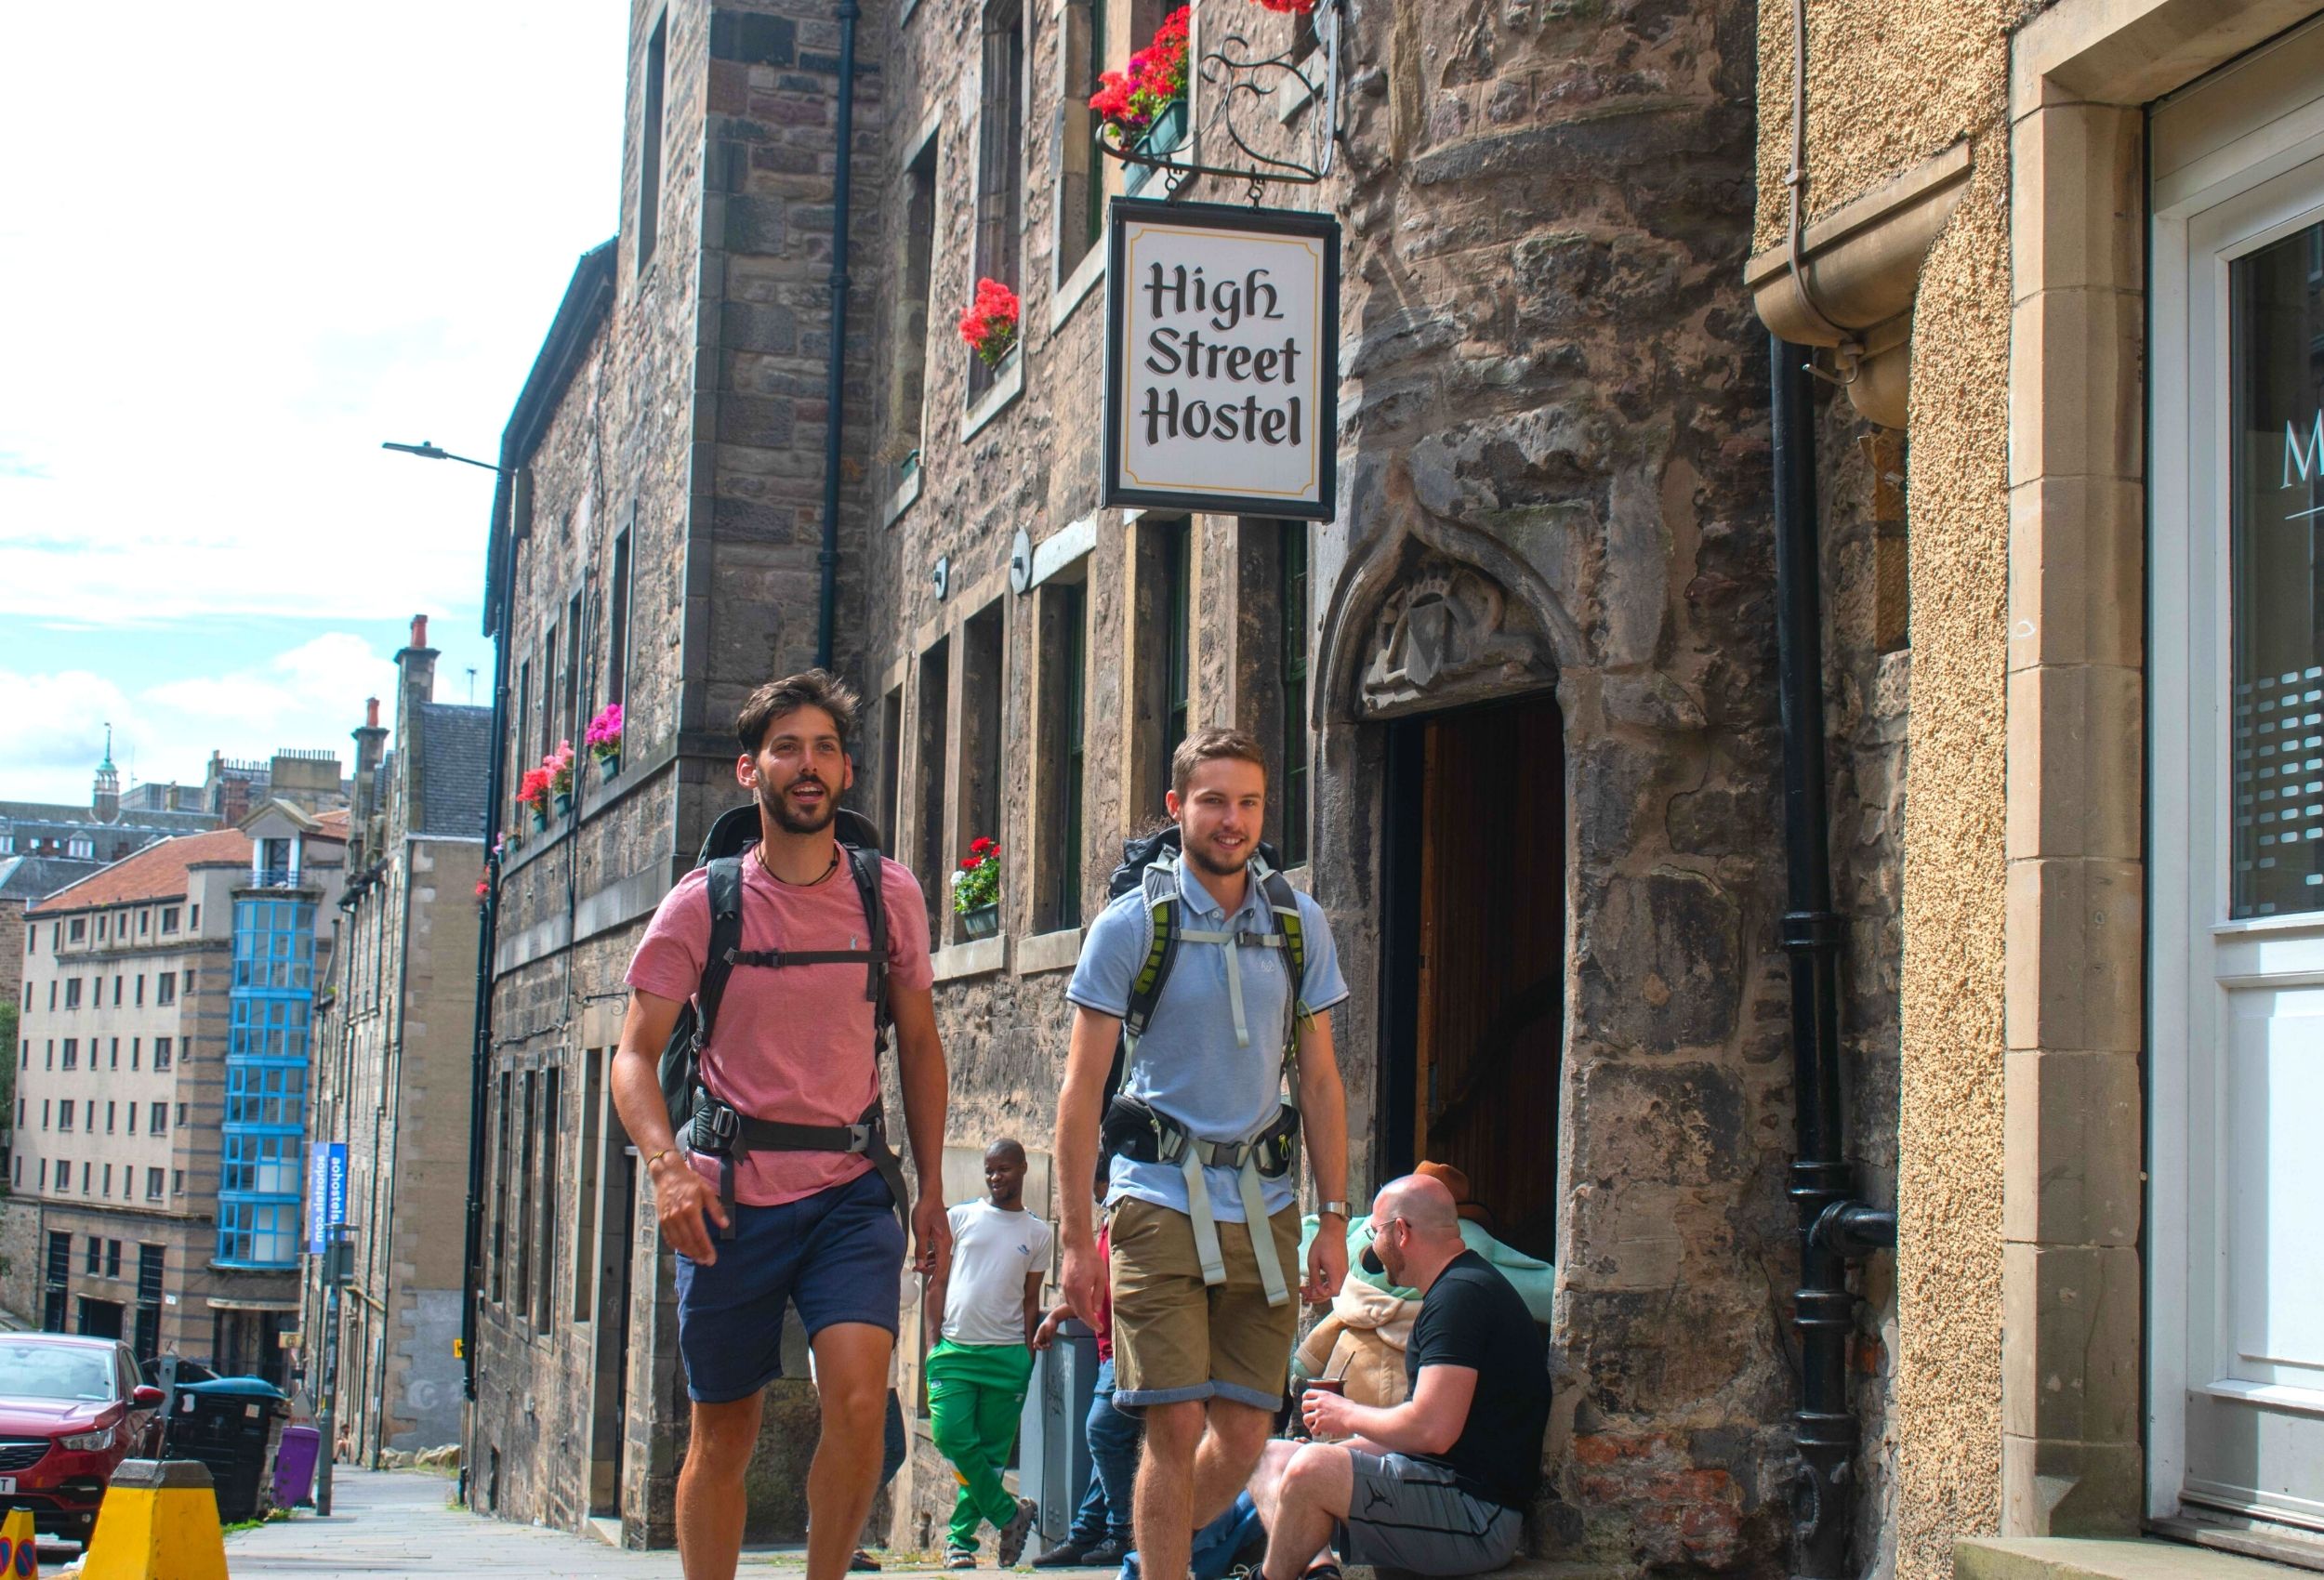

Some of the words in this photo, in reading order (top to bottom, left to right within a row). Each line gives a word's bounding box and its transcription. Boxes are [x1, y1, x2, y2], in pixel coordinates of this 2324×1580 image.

[1143, 262, 1284, 331] High
[1144, 327, 1301, 385] Street
[1141, 387, 1301, 446] Hostel
